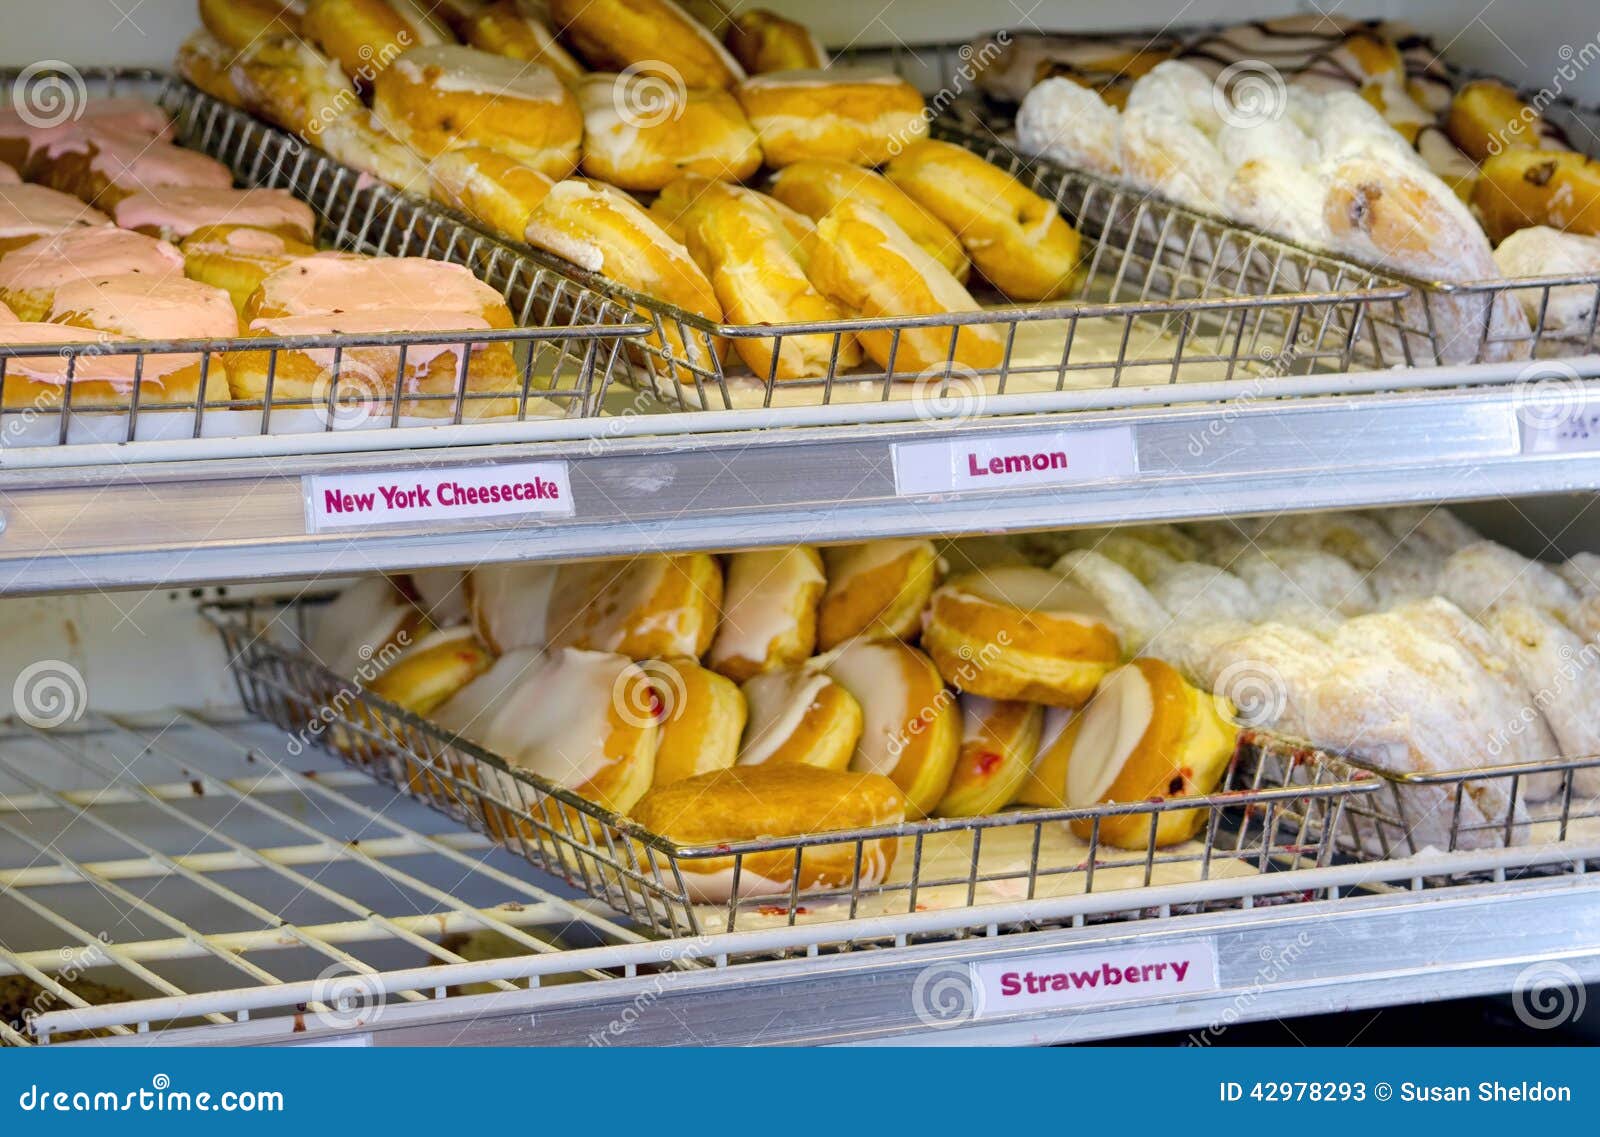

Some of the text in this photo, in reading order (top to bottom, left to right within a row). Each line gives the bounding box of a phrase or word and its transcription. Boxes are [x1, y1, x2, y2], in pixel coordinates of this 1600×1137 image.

[968, 451, 1068, 477] Lemon
[324, 475, 559, 514] New York Cheesecake
[1000, 960, 1190, 997] Strawberry
